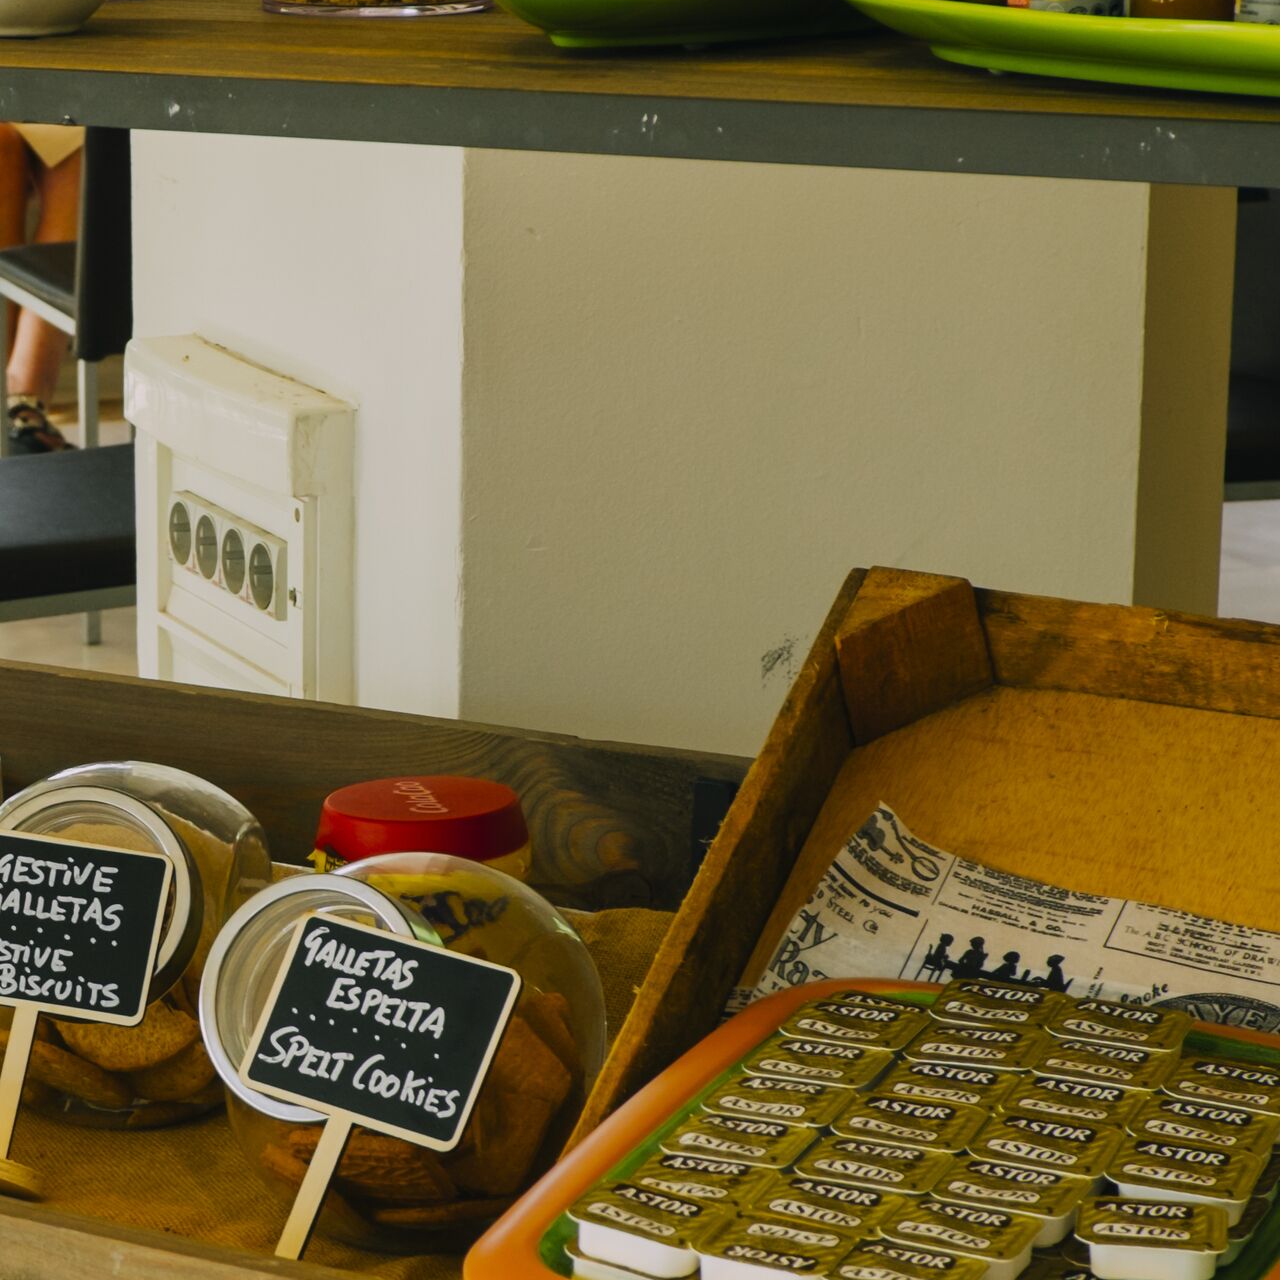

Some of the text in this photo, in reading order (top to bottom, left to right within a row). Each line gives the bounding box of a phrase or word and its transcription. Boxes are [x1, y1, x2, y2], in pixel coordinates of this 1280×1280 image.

[304, 927, 419, 991] GALLETAS
[961, 985, 1040, 1004] ASTOR
[326, 977, 446, 1040] ESPELTA
[820, 1005, 895, 1021] ASTOR
[1078, 1001, 1160, 1023] ASTOR
[936, 1028, 1018, 1042] ASTOR
[258, 1026, 355, 1082] SPELT
[782, 1042, 860, 1058] ASTOR
[1063, 1041, 1146, 1063] ASTOR
[912, 1063, 993, 1084] ASTOR
[1197, 1064, 1280, 1085] ASTOR
[742, 1078, 821, 1093] ASTOR
[1038, 1080, 1119, 1101] ASTOR
[869, 1100, 951, 1119] ASTOR
[1162, 1102, 1248, 1125] ASTOR
[703, 1117, 783, 1136] ASTOR
[1007, 1120, 1091, 1142] ASTOR
[836, 1142, 920, 1160] ASTOR
[992, 1140, 1075, 1165] ASTOR
[1137, 1143, 1225, 1166] ASTOR
[663, 1157, 745, 1175] ASTOR
[970, 1164, 1056, 1185] ASTOR
[615, 1188, 697, 1216] ASTOR
[793, 1181, 877, 1205] ASTOR
[921, 1202, 1007, 1227] ASTOR
[1099, 1203, 1187, 1218] ASTOR
[1098, 1224, 1188, 1240] ASTOR
[728, 1246, 814, 1268] ASTOR
[863, 1245, 951, 1268] ASTOR
